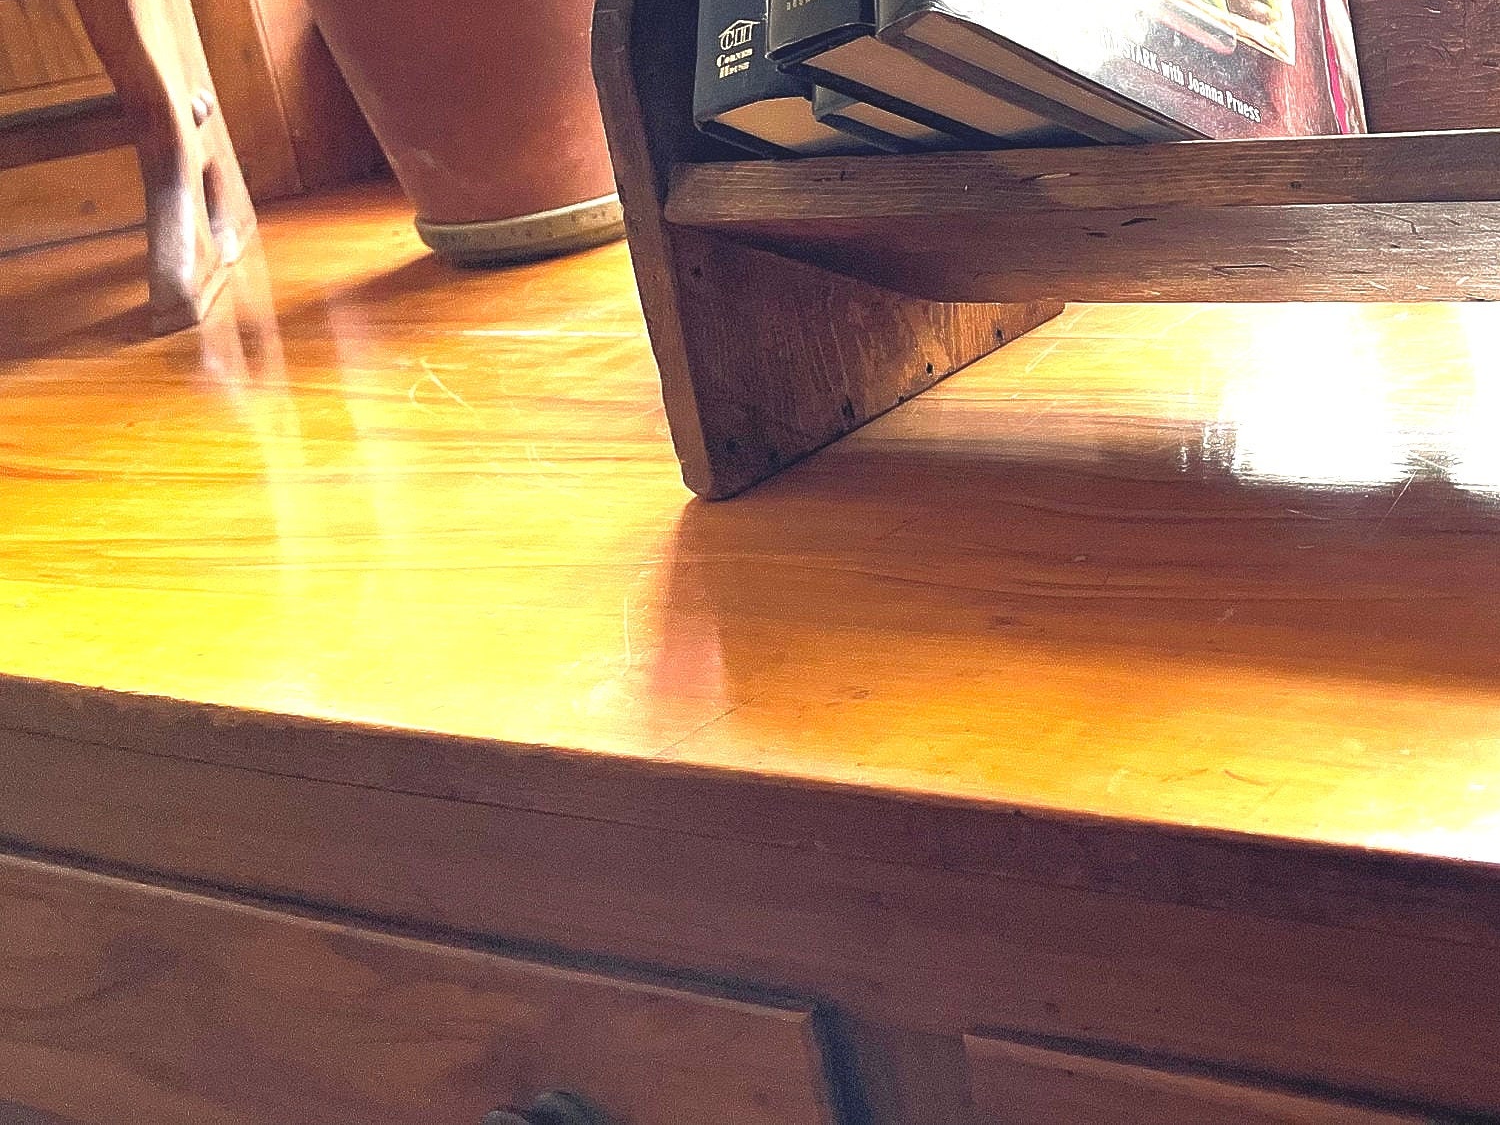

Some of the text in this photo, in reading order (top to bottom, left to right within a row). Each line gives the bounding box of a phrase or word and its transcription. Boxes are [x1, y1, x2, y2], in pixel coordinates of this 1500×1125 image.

[1160, 60, 1185, 86] with
[1187, 71, 1226, 106] Joanna
[1225, 89, 1263, 124] Pruess
